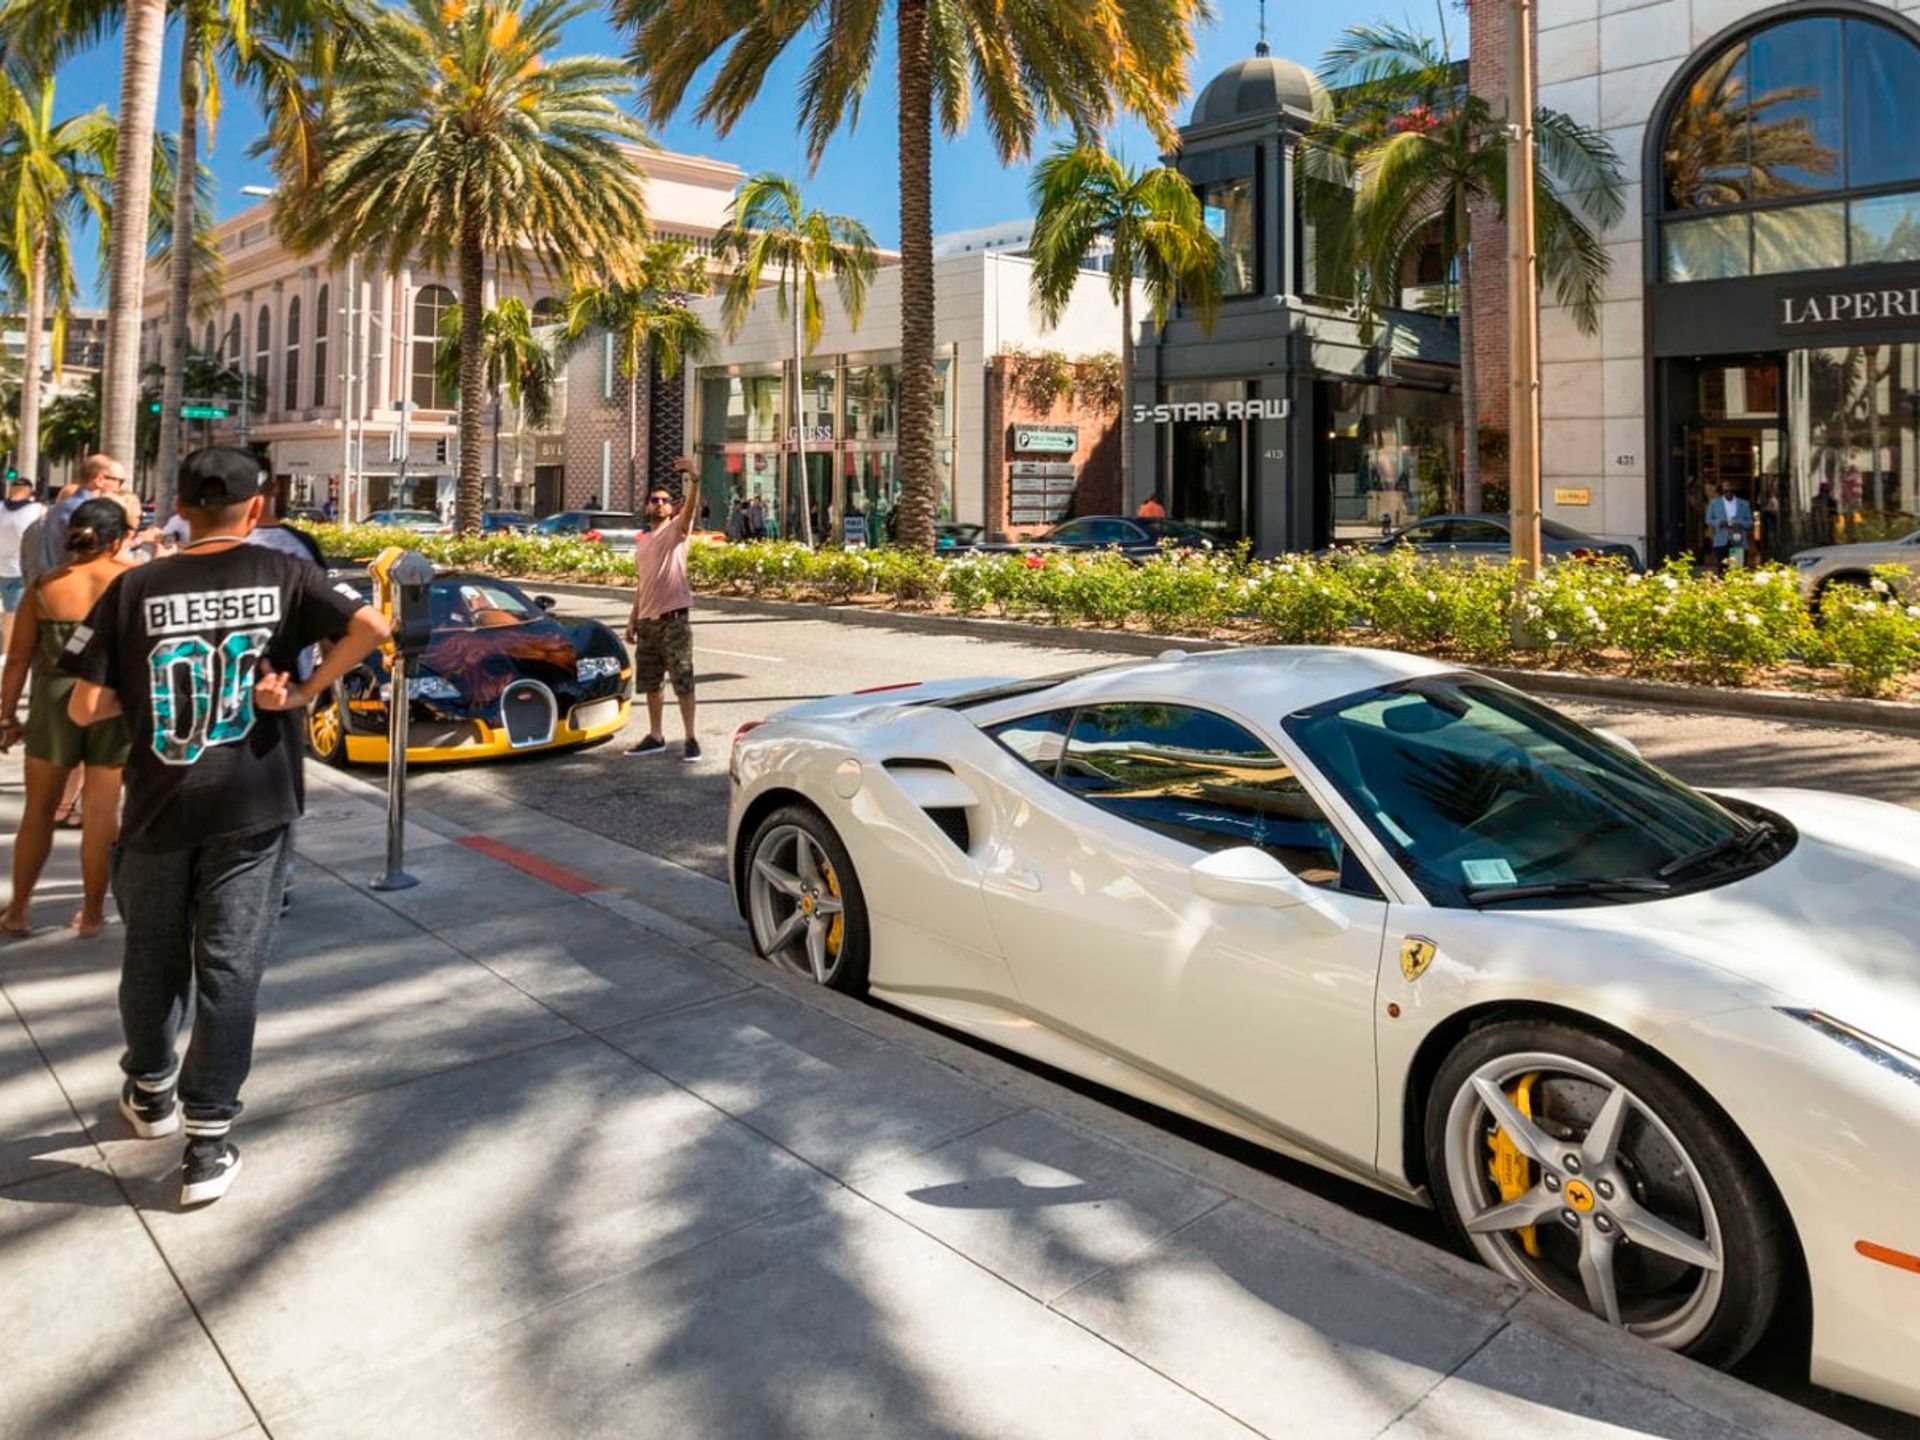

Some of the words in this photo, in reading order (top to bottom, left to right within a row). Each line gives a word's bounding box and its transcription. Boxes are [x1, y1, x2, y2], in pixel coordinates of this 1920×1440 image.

[1226, 398, 1290, 420] RAW
[1264, 450, 1284, 459] 413
[150, 593, 274, 628] BLESSED
